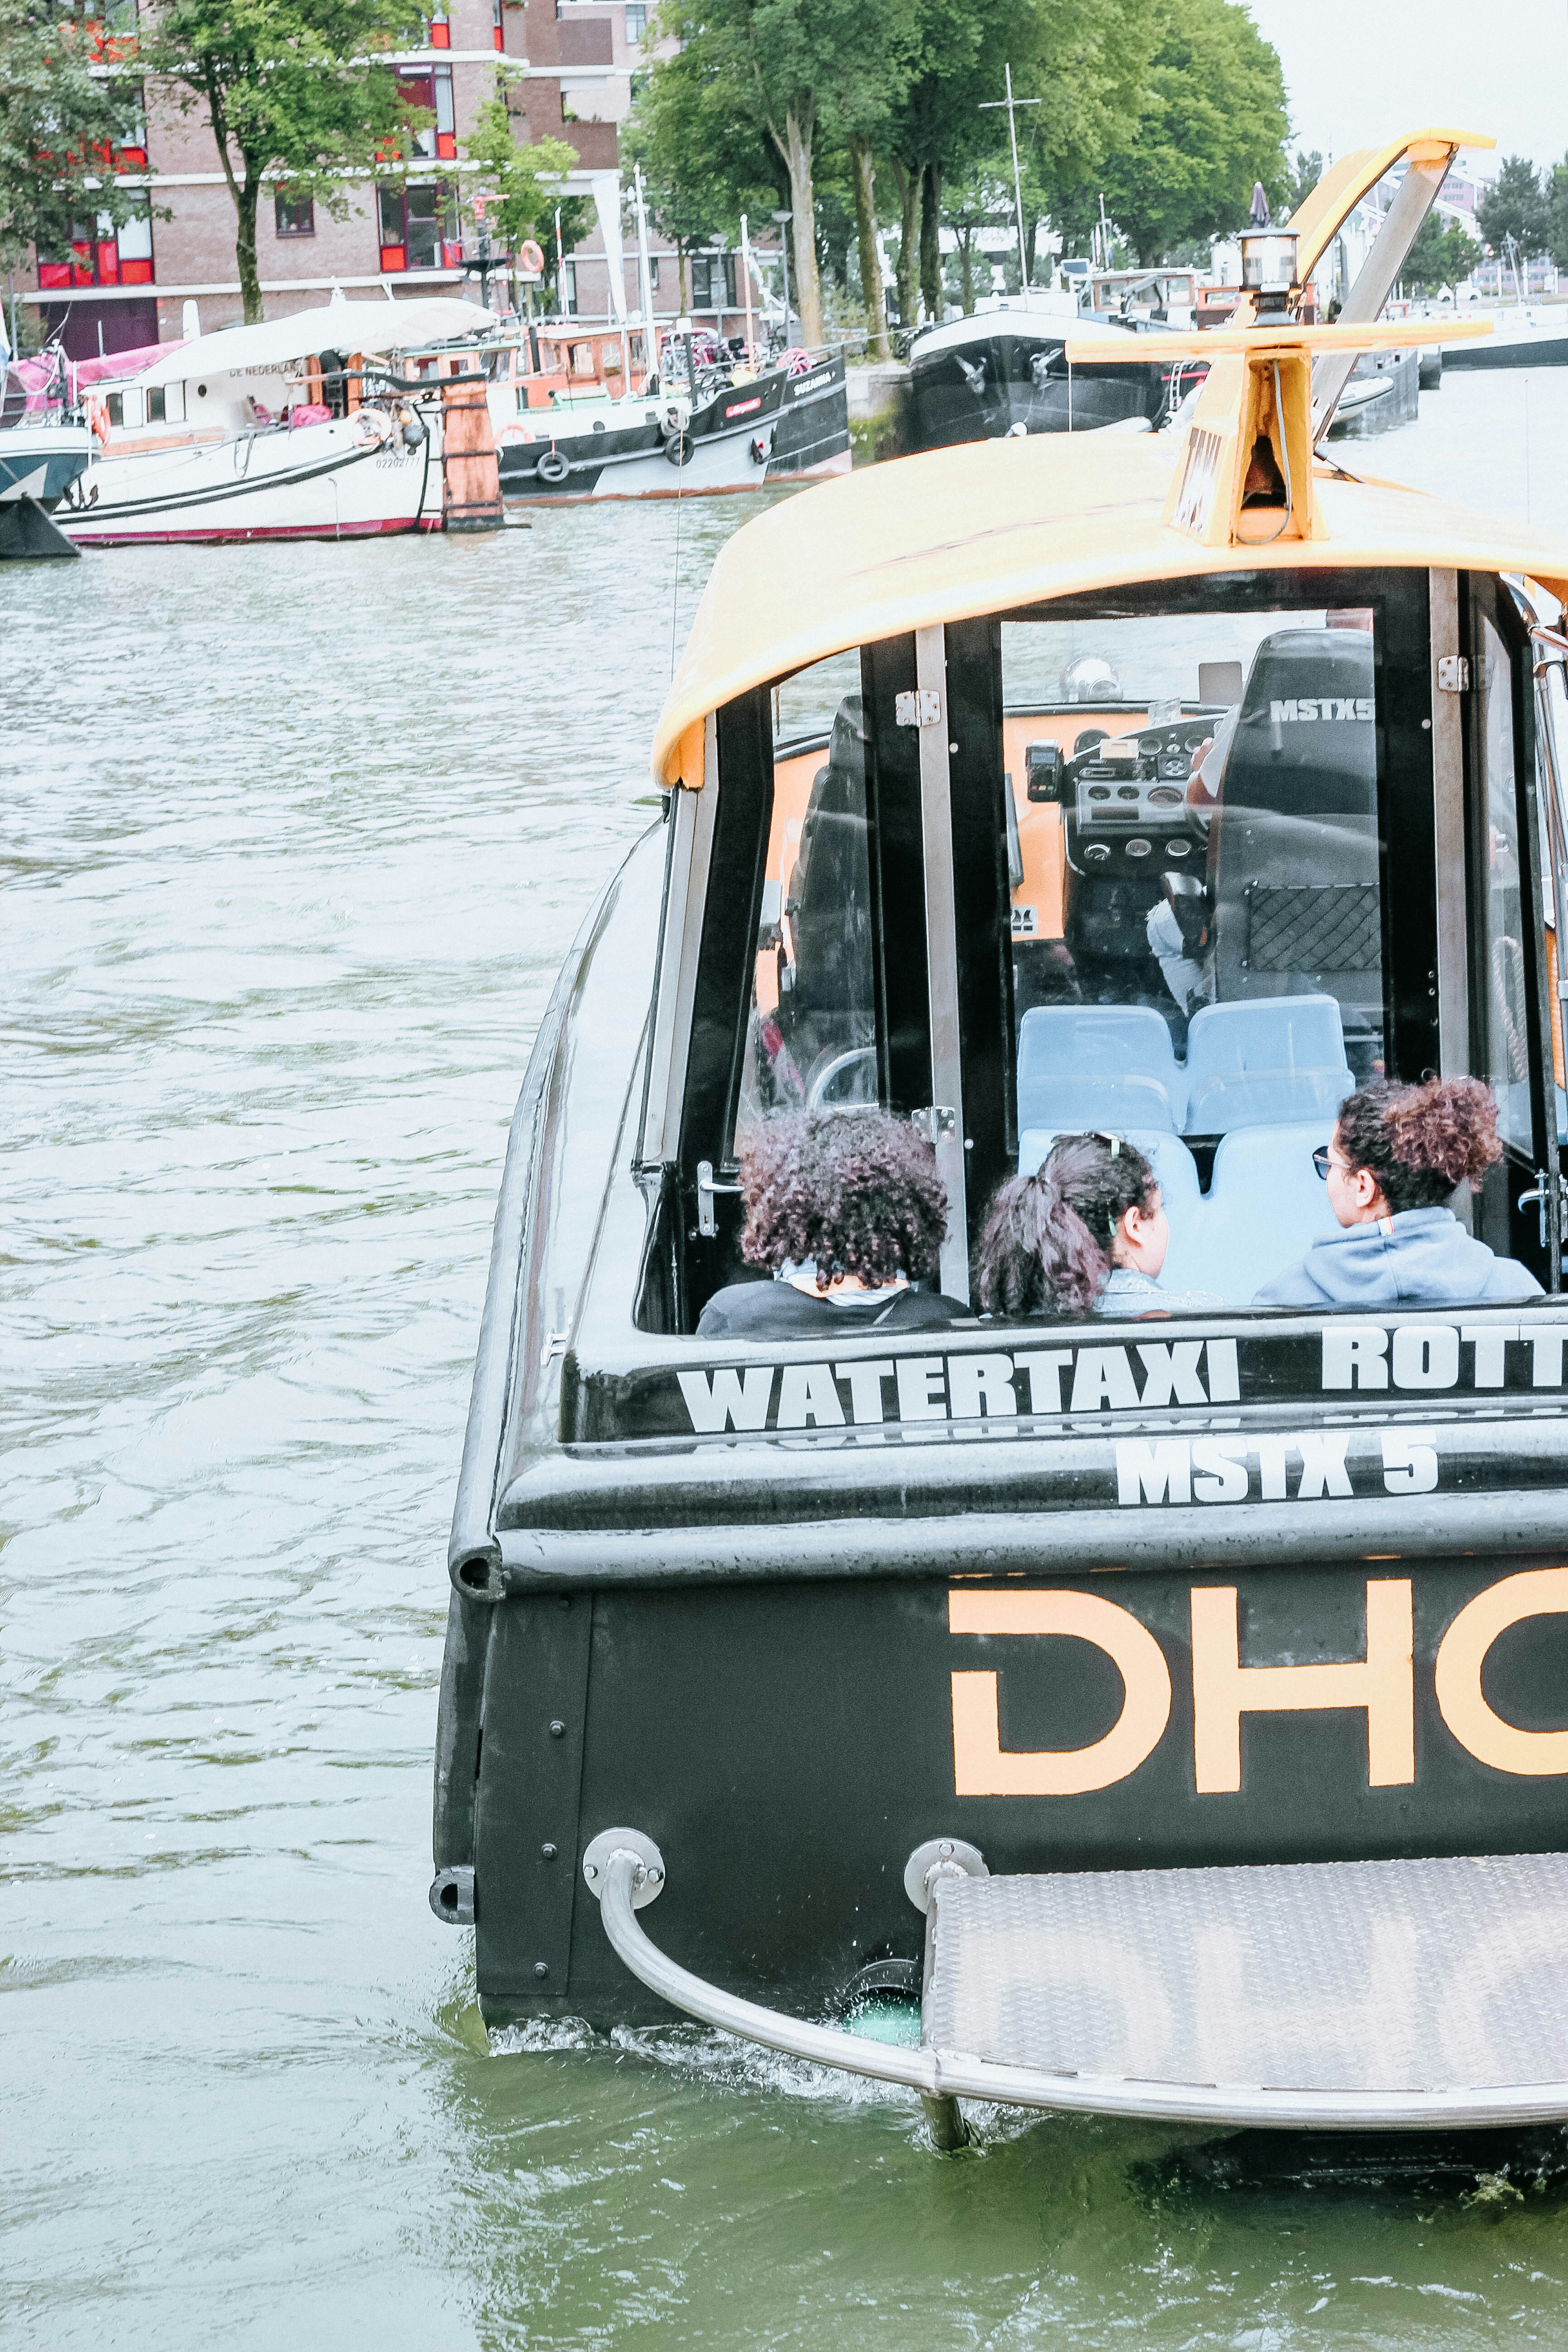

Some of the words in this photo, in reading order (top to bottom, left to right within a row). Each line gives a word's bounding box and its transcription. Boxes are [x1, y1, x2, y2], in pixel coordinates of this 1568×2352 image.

[1270, 698, 1375, 722] MSTX5
[676, 1338, 1241, 1433] WATERTAXI
[1321, 1323, 1568, 1390] ROTT
[1115, 1432, 1354, 1505] MSTX
[1380, 1429, 1439, 1494] 5
